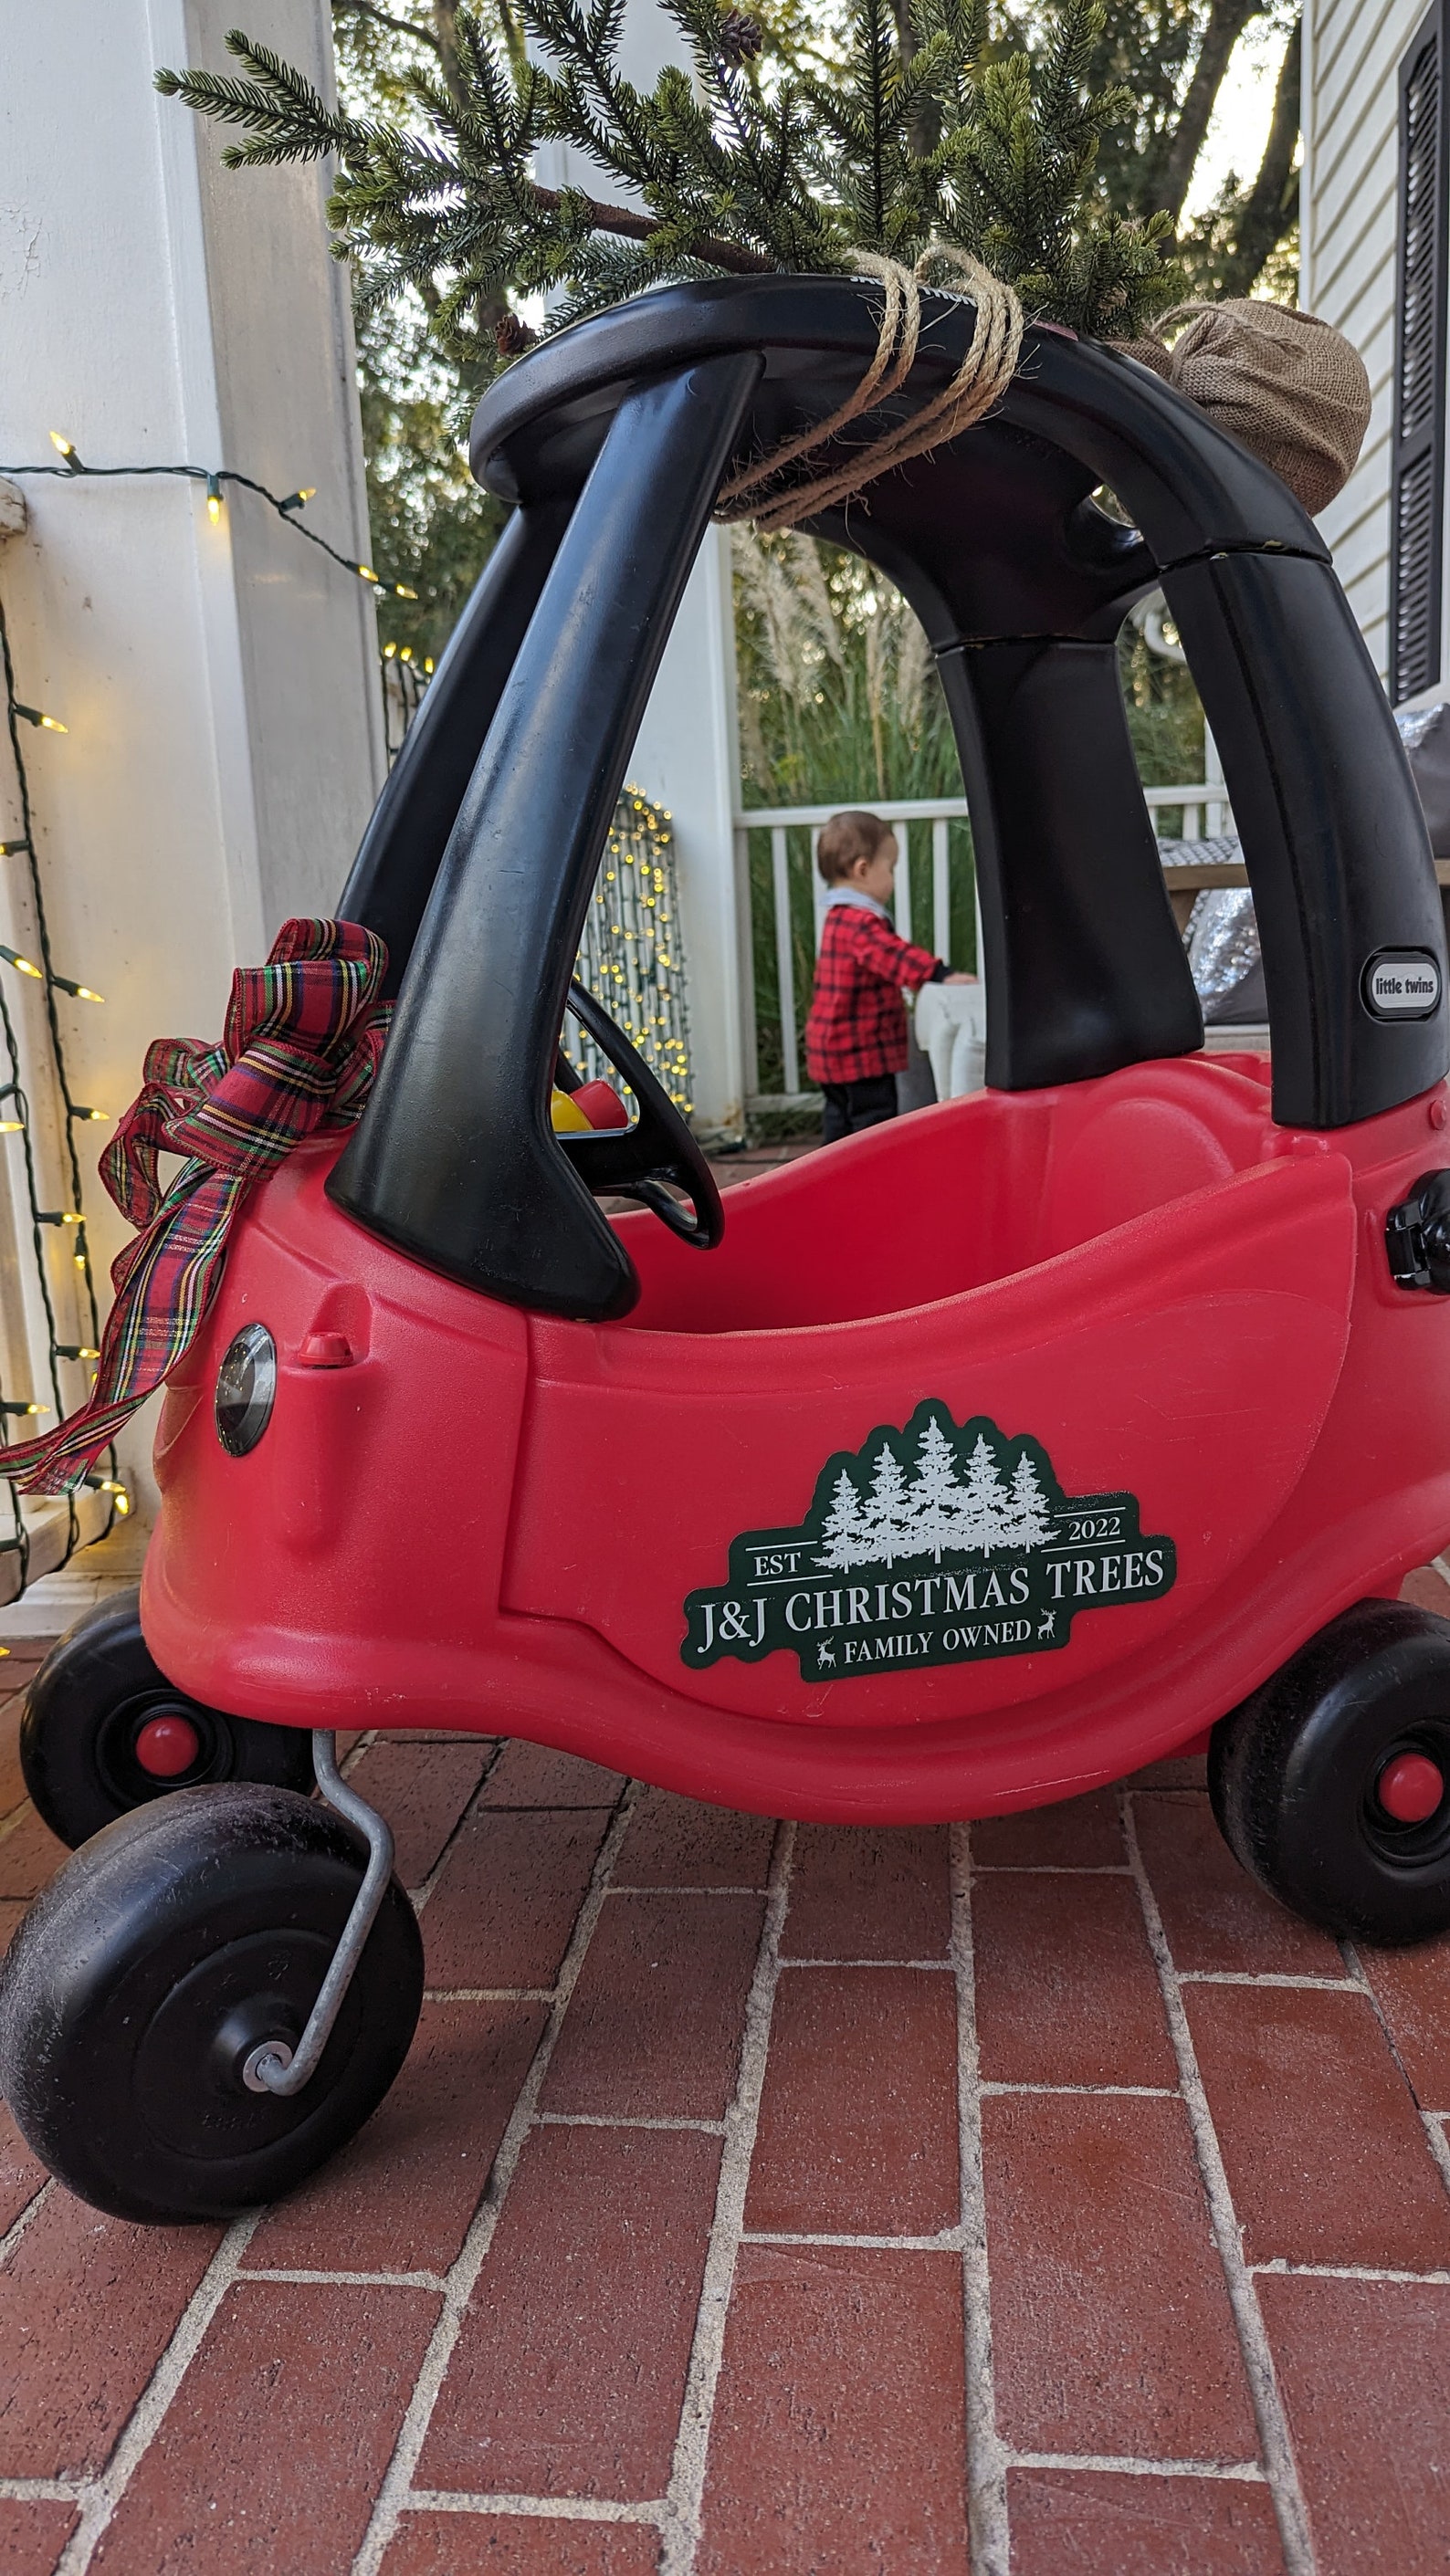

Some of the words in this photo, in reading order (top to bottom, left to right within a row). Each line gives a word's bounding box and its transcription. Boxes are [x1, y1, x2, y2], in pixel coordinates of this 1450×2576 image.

[1376, 978, 1403, 995] little
[1067, 1516, 1121, 1543] 2022
[753, 1552, 802, 1577] EST
[698, 1597, 769, 1654] J&J
[784, 1567, 1031, 1633] CHRISTMAS
[1046, 1549, 1164, 1599] TREES
[844, 1631, 935, 1665] FAMILY
[943, 1619, 1032, 1652] OWNED
